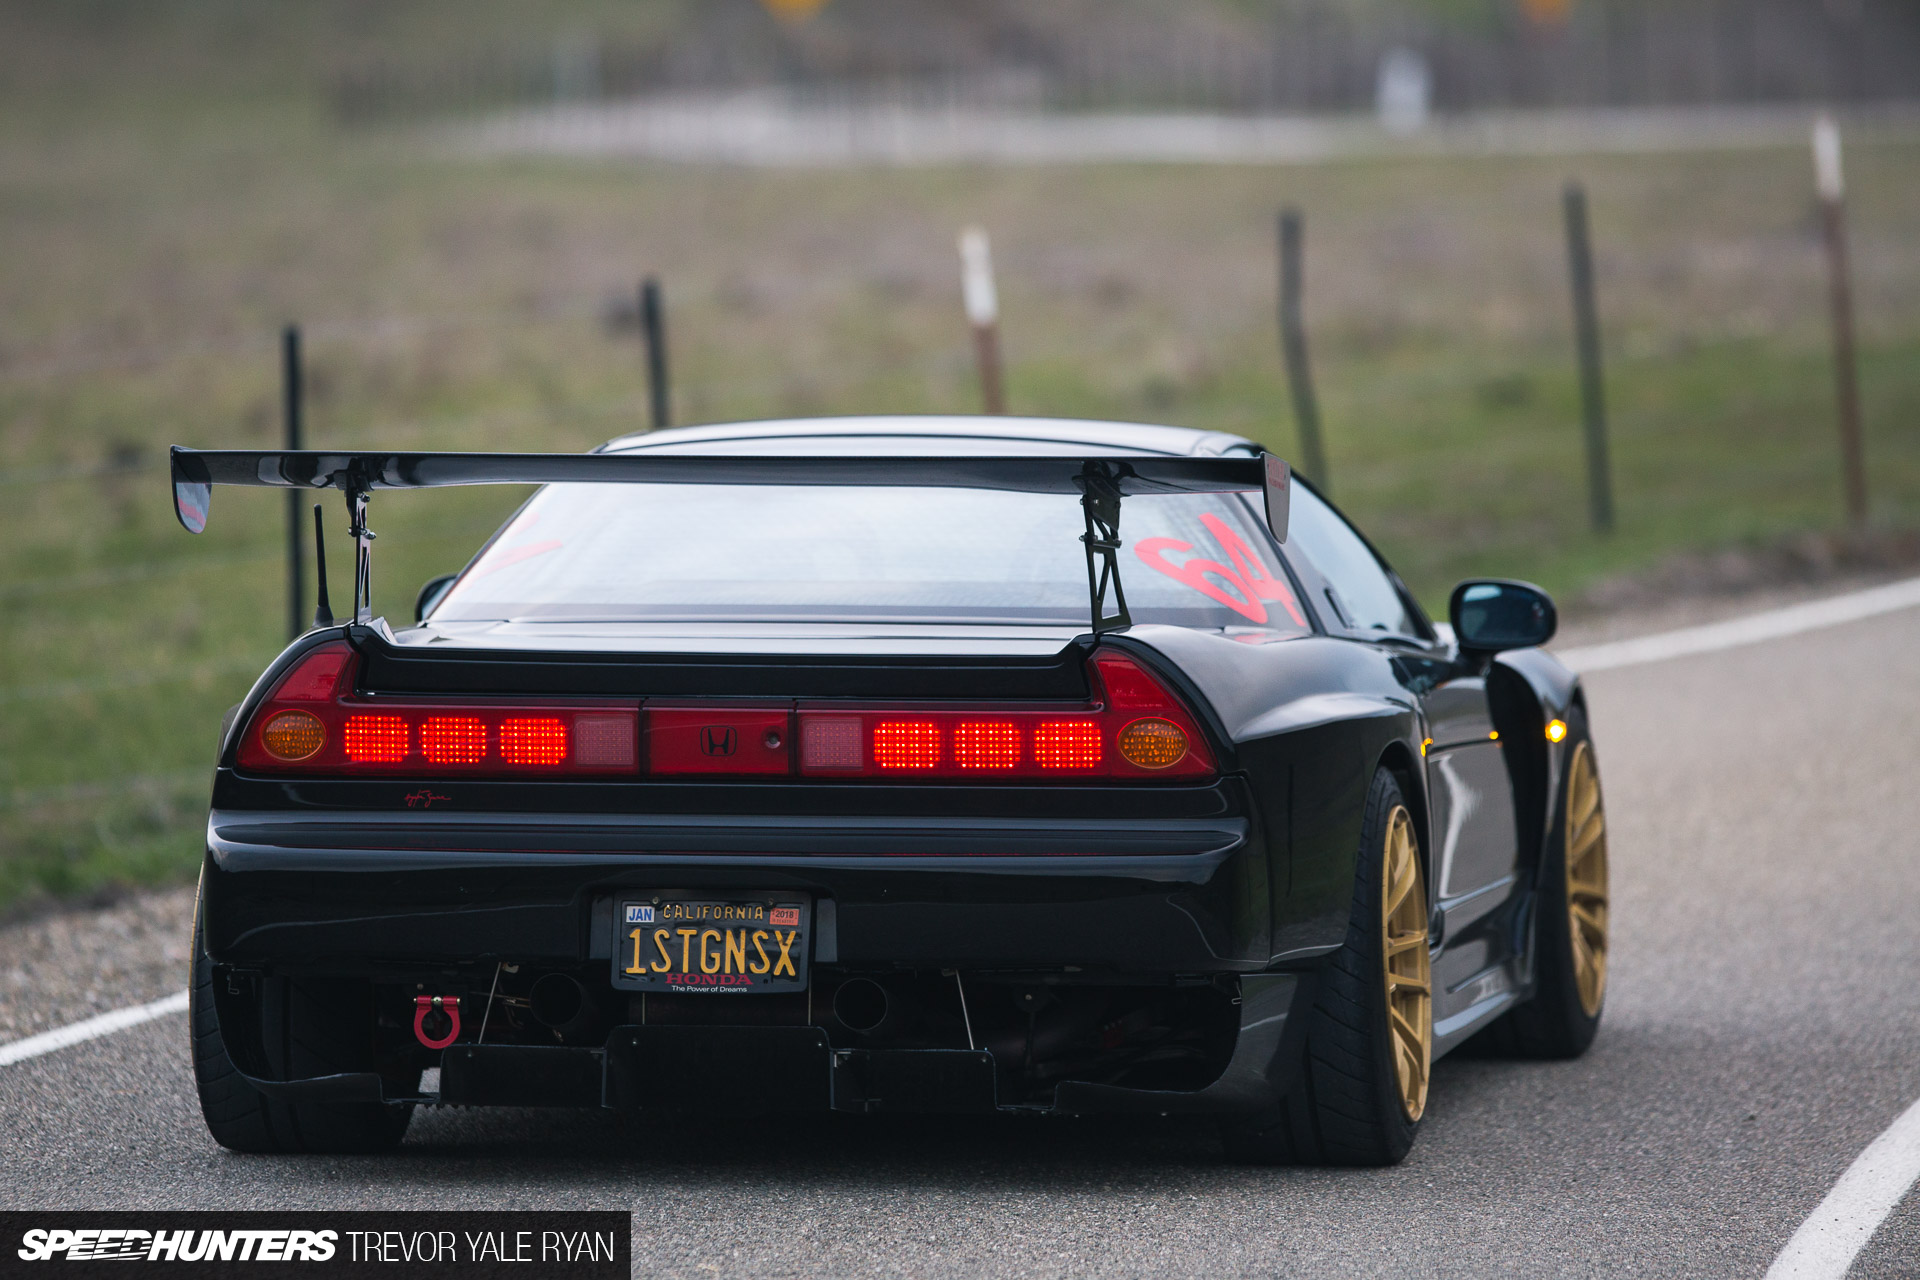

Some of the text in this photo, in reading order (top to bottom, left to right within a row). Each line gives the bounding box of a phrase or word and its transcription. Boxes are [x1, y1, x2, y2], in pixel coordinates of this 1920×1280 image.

[1134, 512, 1306, 627] 64
[628, 907, 652, 921] JAN
[662, 905, 764, 920] CALIFORNIA
[775, 910, 794, 919] 2018
[625, 929, 796, 977] 1STGNSX
[665, 973, 753, 985] HONDA
[687, 985, 709, 993] Power
